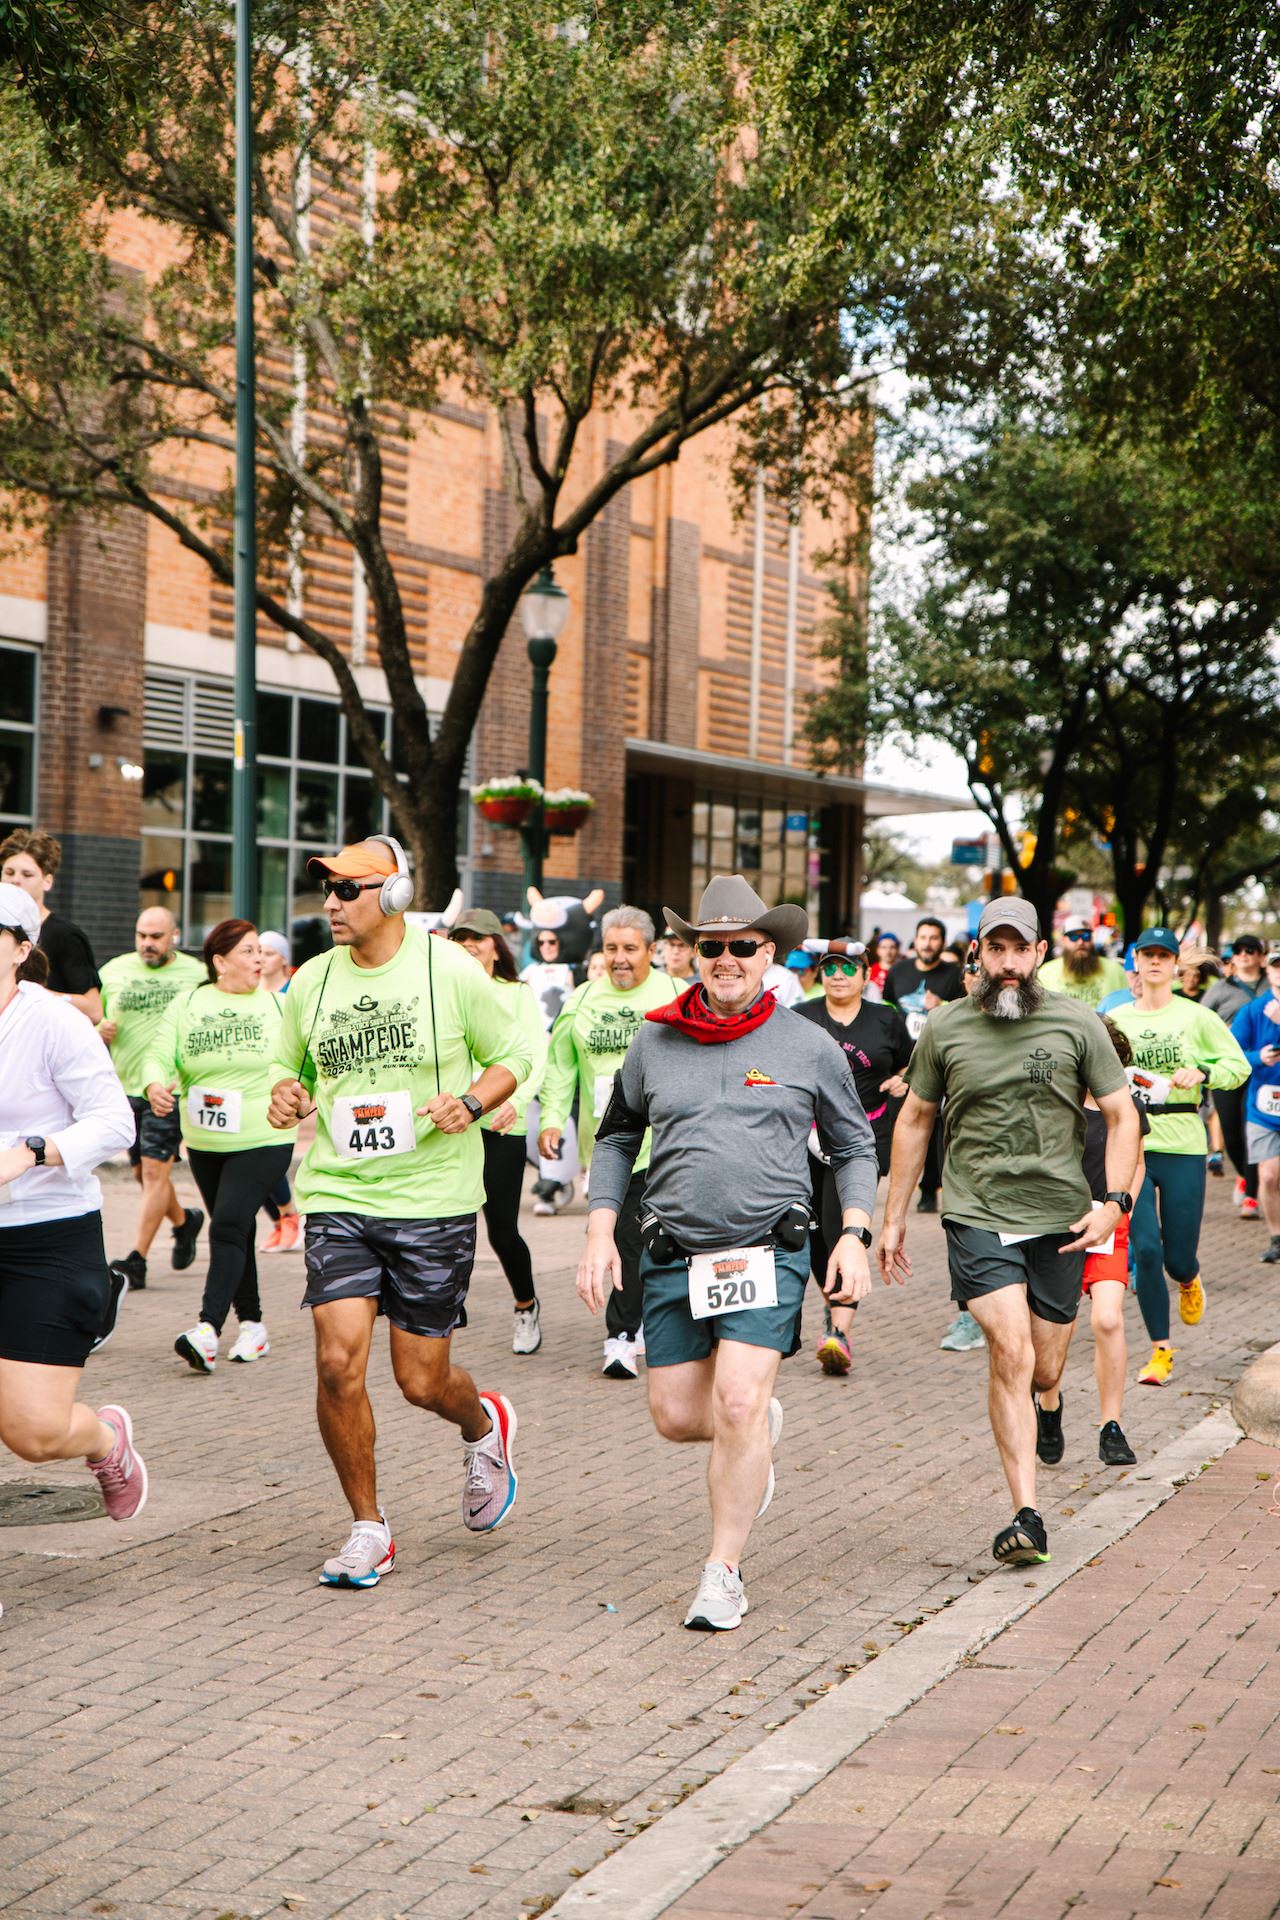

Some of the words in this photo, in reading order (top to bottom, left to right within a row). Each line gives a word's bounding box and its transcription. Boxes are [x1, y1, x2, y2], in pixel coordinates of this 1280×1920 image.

[188, 1026, 262, 1050] STAMPEDE
[318, 1021, 415, 1068] STAMPEDE
[589, 1026, 639, 1047] STAMP
[392, 1054, 408, 1063] 5K
[326, 1063, 352, 1077] 2024
[1029, 1069, 1053, 1084] 1949
[198, 1109, 227, 1128] 176
[349, 1126, 396, 1152] 443
[706, 1279, 757, 1309] 520
